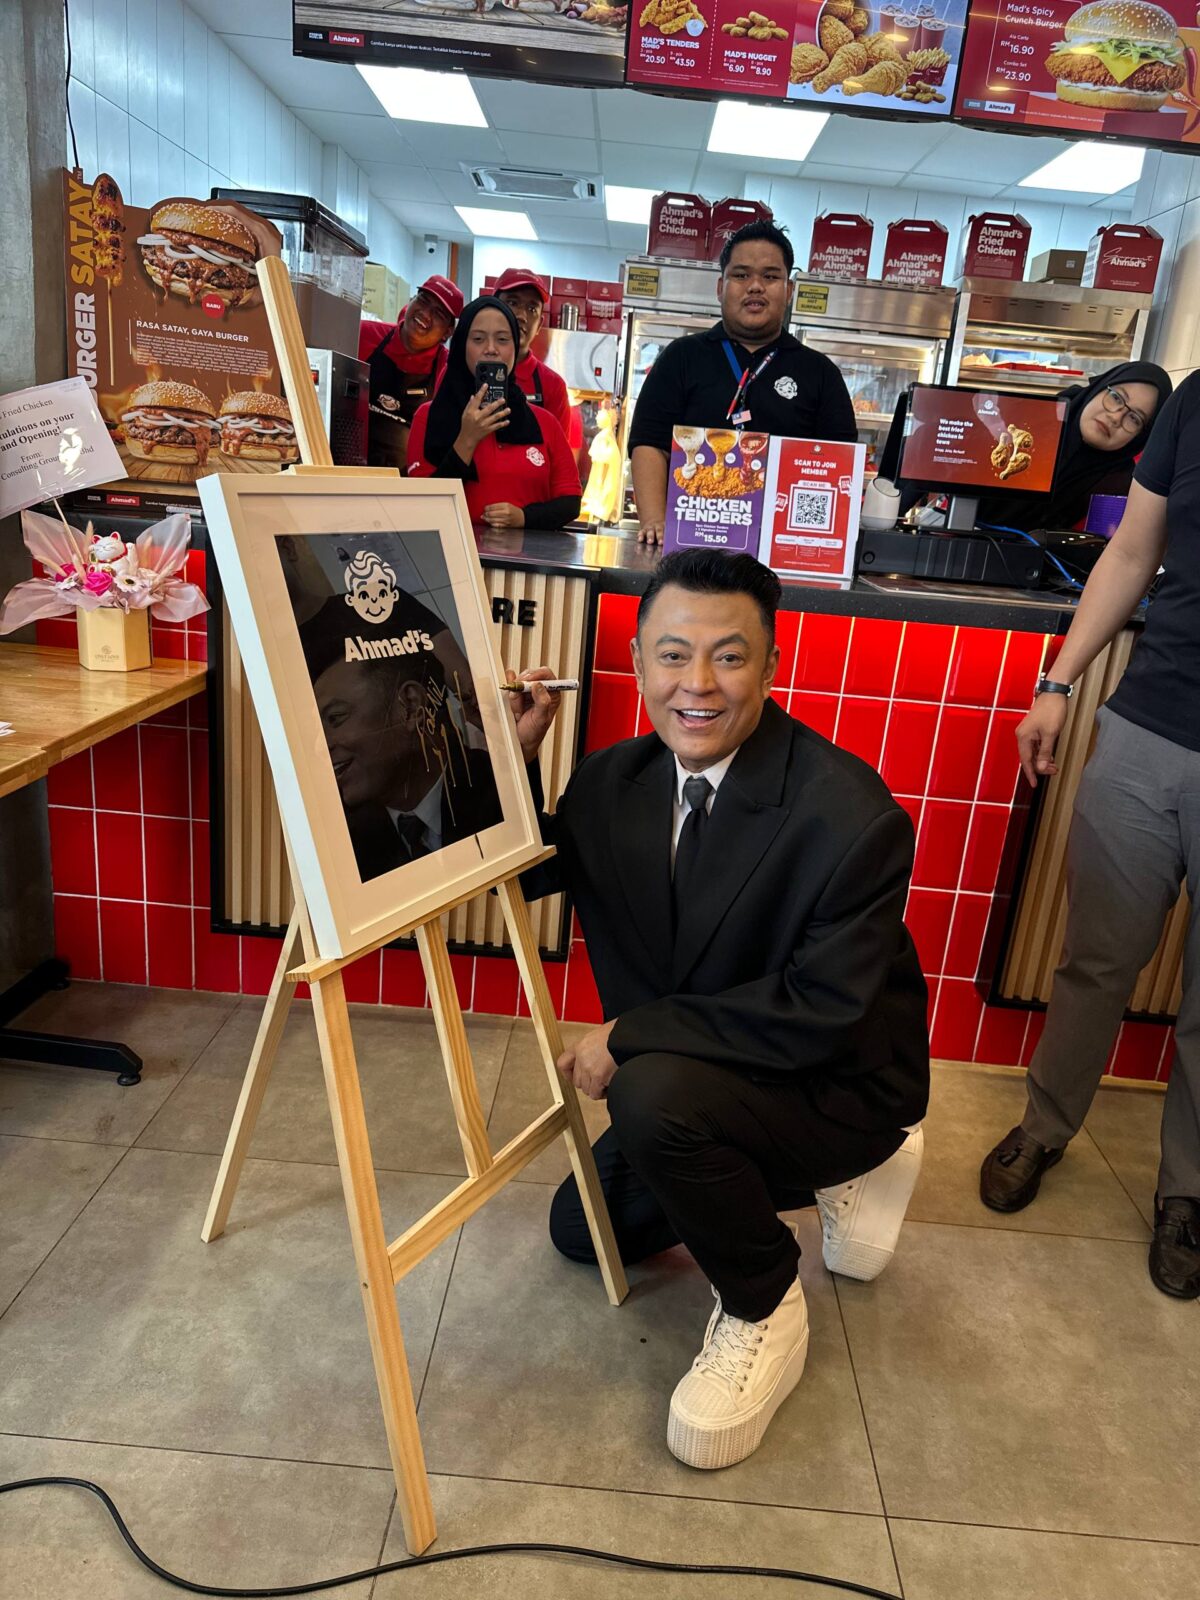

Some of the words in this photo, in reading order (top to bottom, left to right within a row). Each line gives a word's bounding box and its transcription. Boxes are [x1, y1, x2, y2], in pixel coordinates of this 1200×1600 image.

[1007, 4, 1030, 13] Mad's
[1032, 6, 1054, 17] Spicy
[1005, 15, 1034, 24] Crunch
[1036, 19, 1063, 29] Burger
[642, 36, 665, 45] MAD'S
[666, 39, 700, 48] TENDERS
[1010, 45, 1034, 55] 16.90
[645, 55, 665, 64] 20.50
[724, 50, 747, 59] MAD'S
[748, 53, 777, 62] NUGGET
[675, 58, 695, 67] 43.50
[728, 64, 745, 73] 6.90
[756, 67, 771, 76] 8.90
[1005, 71, 1031, 81] 23.90
[661, 206, 704, 219] Ahmad's
[660, 215, 685, 225] Fried
[69, 178, 95, 286] SATAY
[659, 224, 698, 237] Chicken
[980, 227, 1024, 239] Ahmad's
[979, 236, 1004, 246] Fried
[826, 246, 867, 256] Ahmad's
[977, 245, 1016, 256] Chicken
[812, 253, 853, 263] Ahmad's
[900, 252, 943, 262] Ahmad's
[1110, 257, 1146, 268] Ahmad's
[824, 261, 864, 271] Ahmad's
[886, 259, 928, 269] Ahmad's
[898, 268, 940, 278] Ahmad's
[885, 274, 925, 284] Ahmad's
[136, 320, 160, 330] RASA
[162, 324, 189, 335] SATAY,
[192, 328, 214, 338] GAYA
[216, 332, 249, 342] BURGER
[75, 292, 98, 405] URGER
[2, 408, 22, 419] Fried
[22, 399, 54, 412] Chicken
[53, 412, 75, 426] your
[18, 426, 62, 444] Opening!
[794, 458, 811, 467] SCAN
[1, 462, 39, 481] Consulting
[677, 495, 752, 513] CHICKEN
[674, 507, 752, 526] TENDERS
[704, 534, 728, 543] 15.50
[344, 630, 434, 662] Ahmad's
